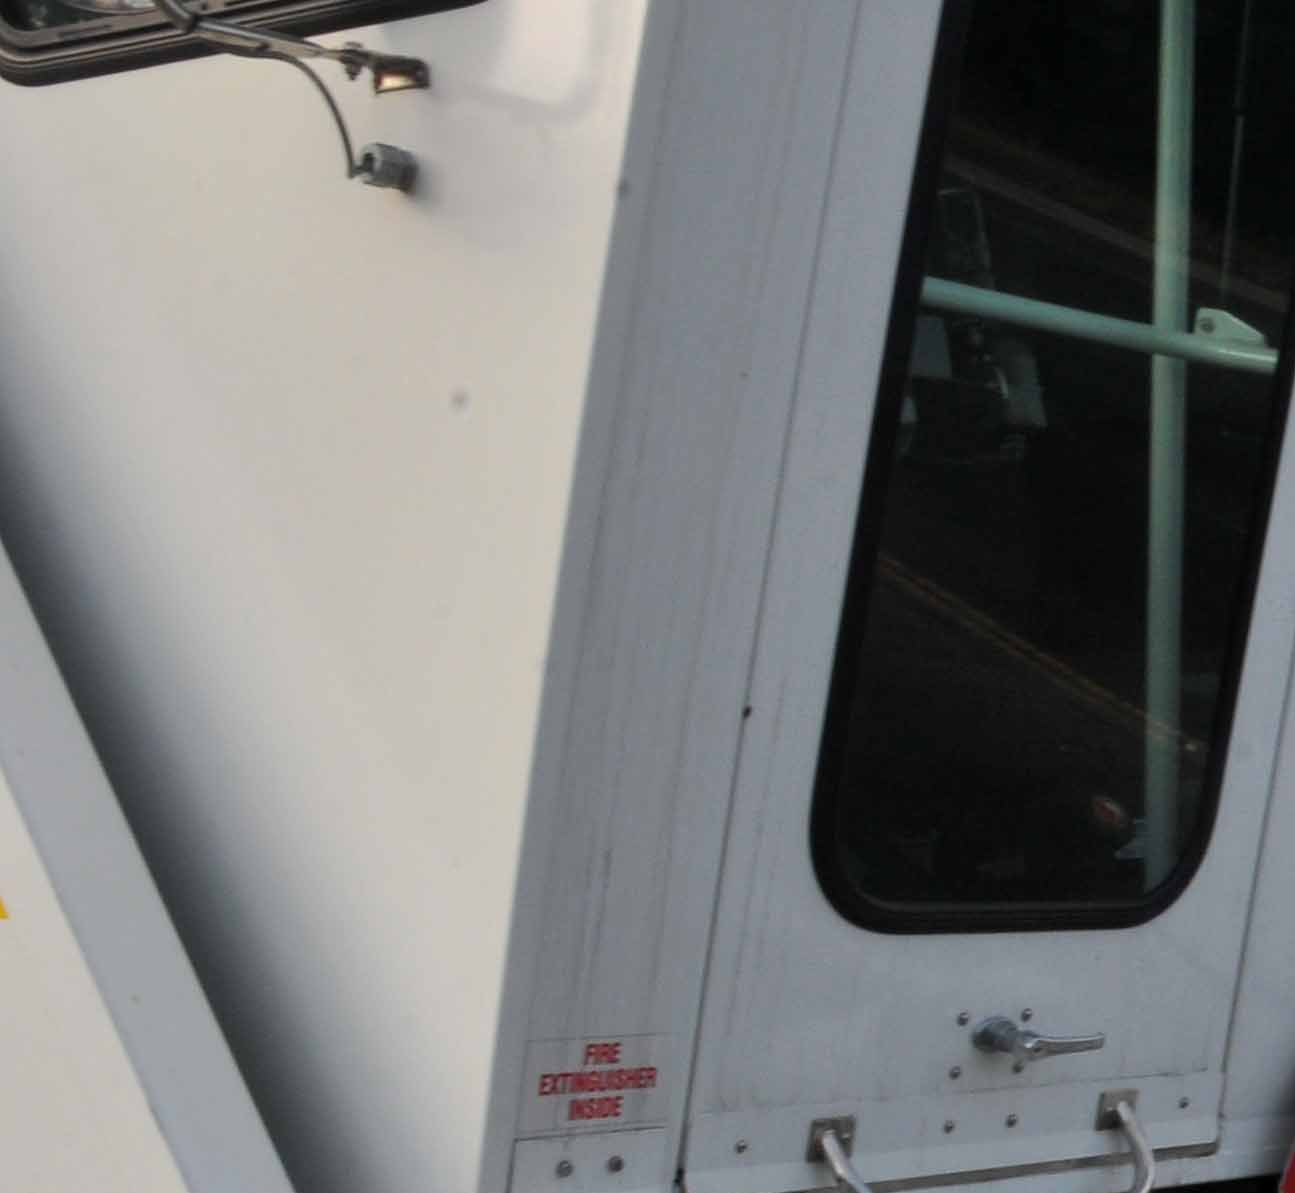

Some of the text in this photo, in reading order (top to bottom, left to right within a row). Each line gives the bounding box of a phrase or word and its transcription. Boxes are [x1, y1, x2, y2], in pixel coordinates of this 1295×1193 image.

[584, 1042, 621, 1065] FIRE
[538, 1067, 657, 1096] EXTINGUISHER
[568, 1096, 624, 1120] INSIDE
